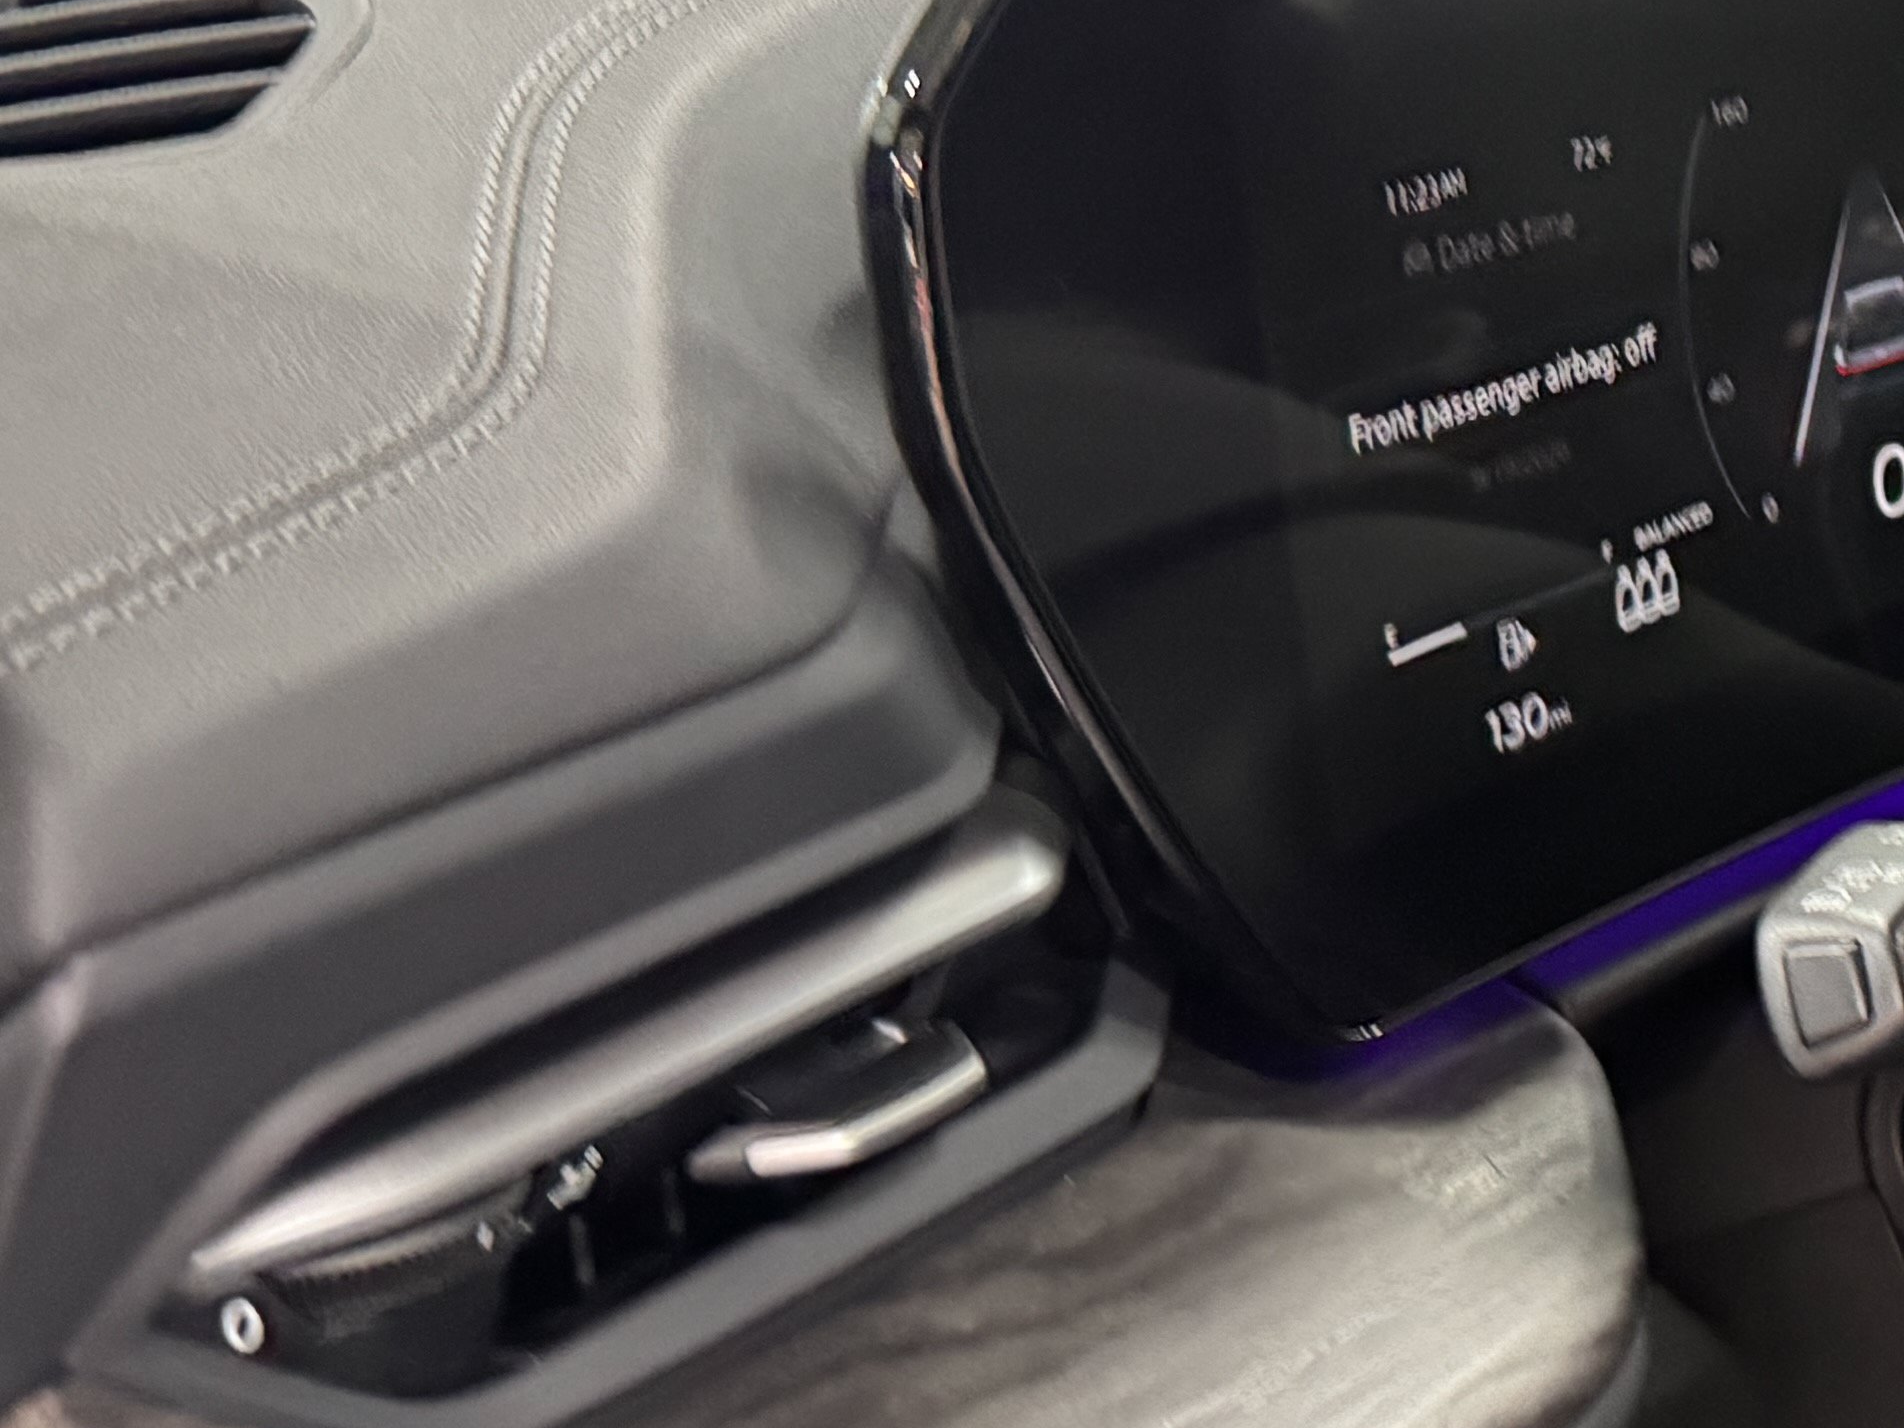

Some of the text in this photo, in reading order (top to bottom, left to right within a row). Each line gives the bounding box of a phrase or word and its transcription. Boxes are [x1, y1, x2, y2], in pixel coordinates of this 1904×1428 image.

[1347, 321, 1659, 457] Front passenger airbag: off
[1484, 690, 1550, 754] 130
